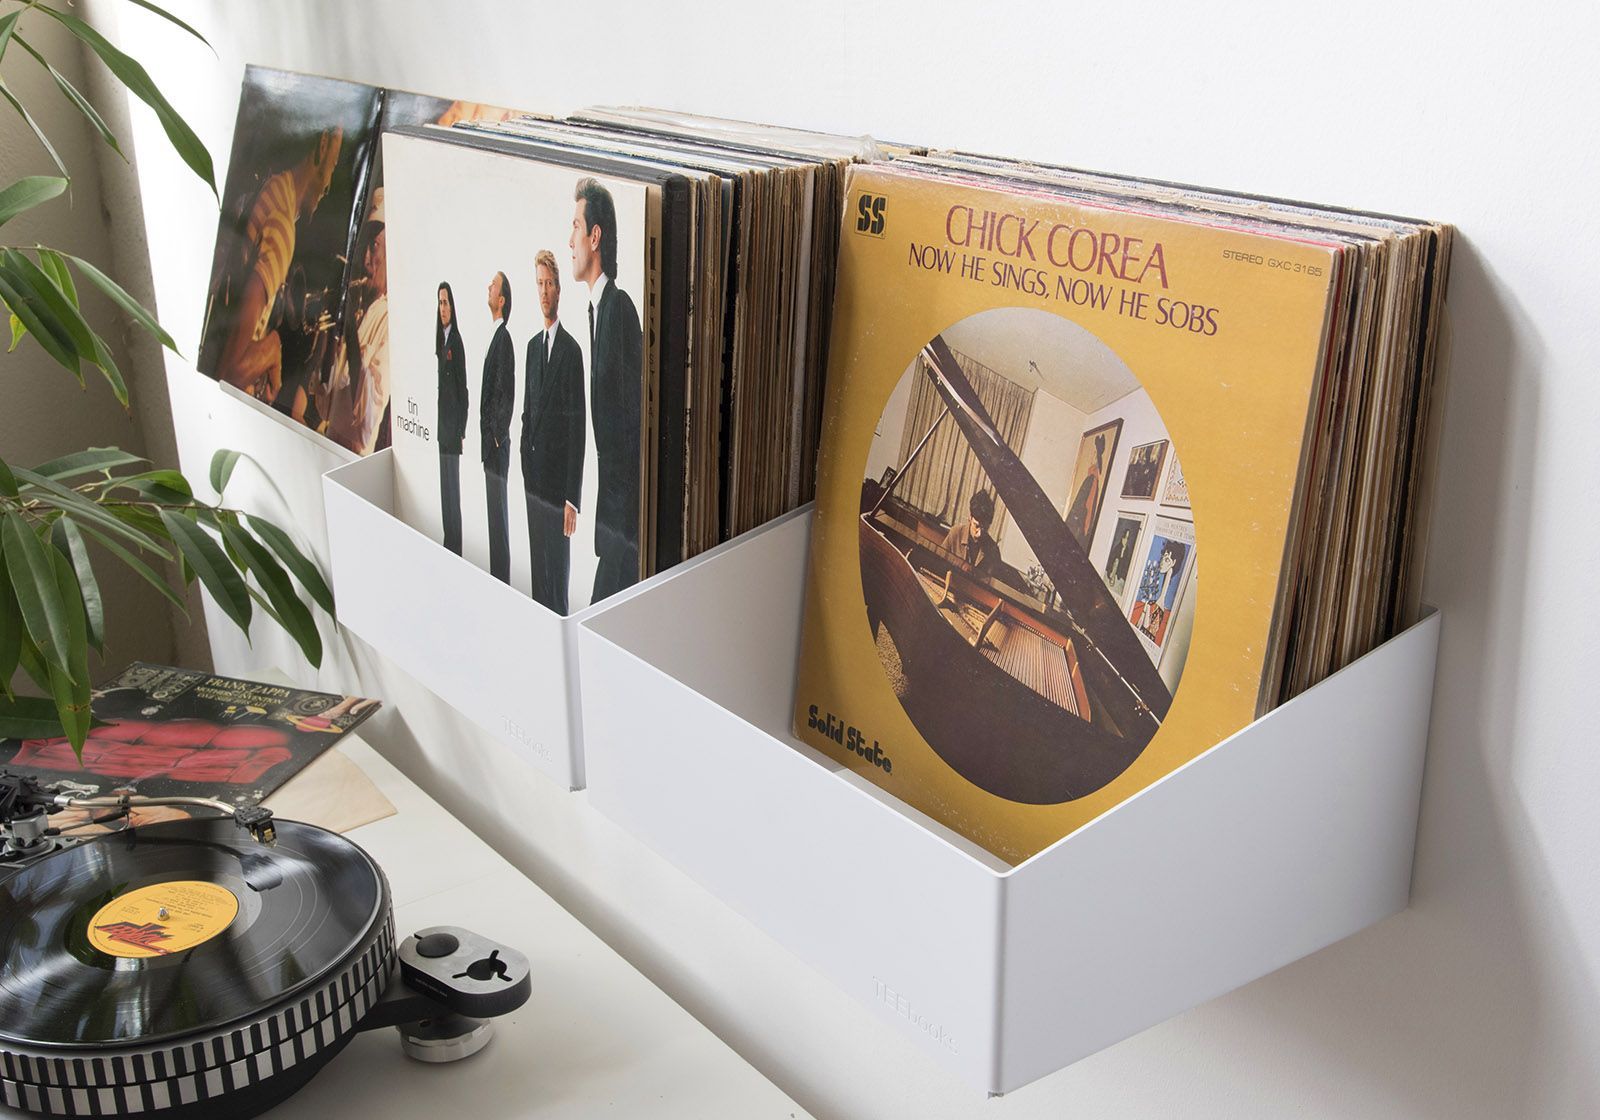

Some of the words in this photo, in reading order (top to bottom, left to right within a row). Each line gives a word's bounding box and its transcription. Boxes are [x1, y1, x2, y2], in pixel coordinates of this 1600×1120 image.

[857, 194, 886, 235] SS
[946, 205, 1040, 261] CHICK
[1047, 223, 1169, 289] COREA
[1222, 249, 1264, 266] STEREO
[1267, 258, 1292, 271] GXC
[1293, 263, 1323, 277] 3165
[908, 242, 956, 274] NOW
[961, 253, 986, 282] HE
[991, 261, 1050, 299] SINGS,
[1055, 275, 1113, 311] NOW
[1119, 289, 1149, 320] HE
[1155, 297, 1219, 336] SOBS
[407, 396, 419, 416] tin
[397, 415, 430, 441] machine
[206, 678, 247, 692] FRANK
[250, 685, 291, 698] ZAPPA
[808, 704, 844, 746] Solid
[847, 726, 892, 773] State
[872, 976, 960, 1056] TEEbooks
